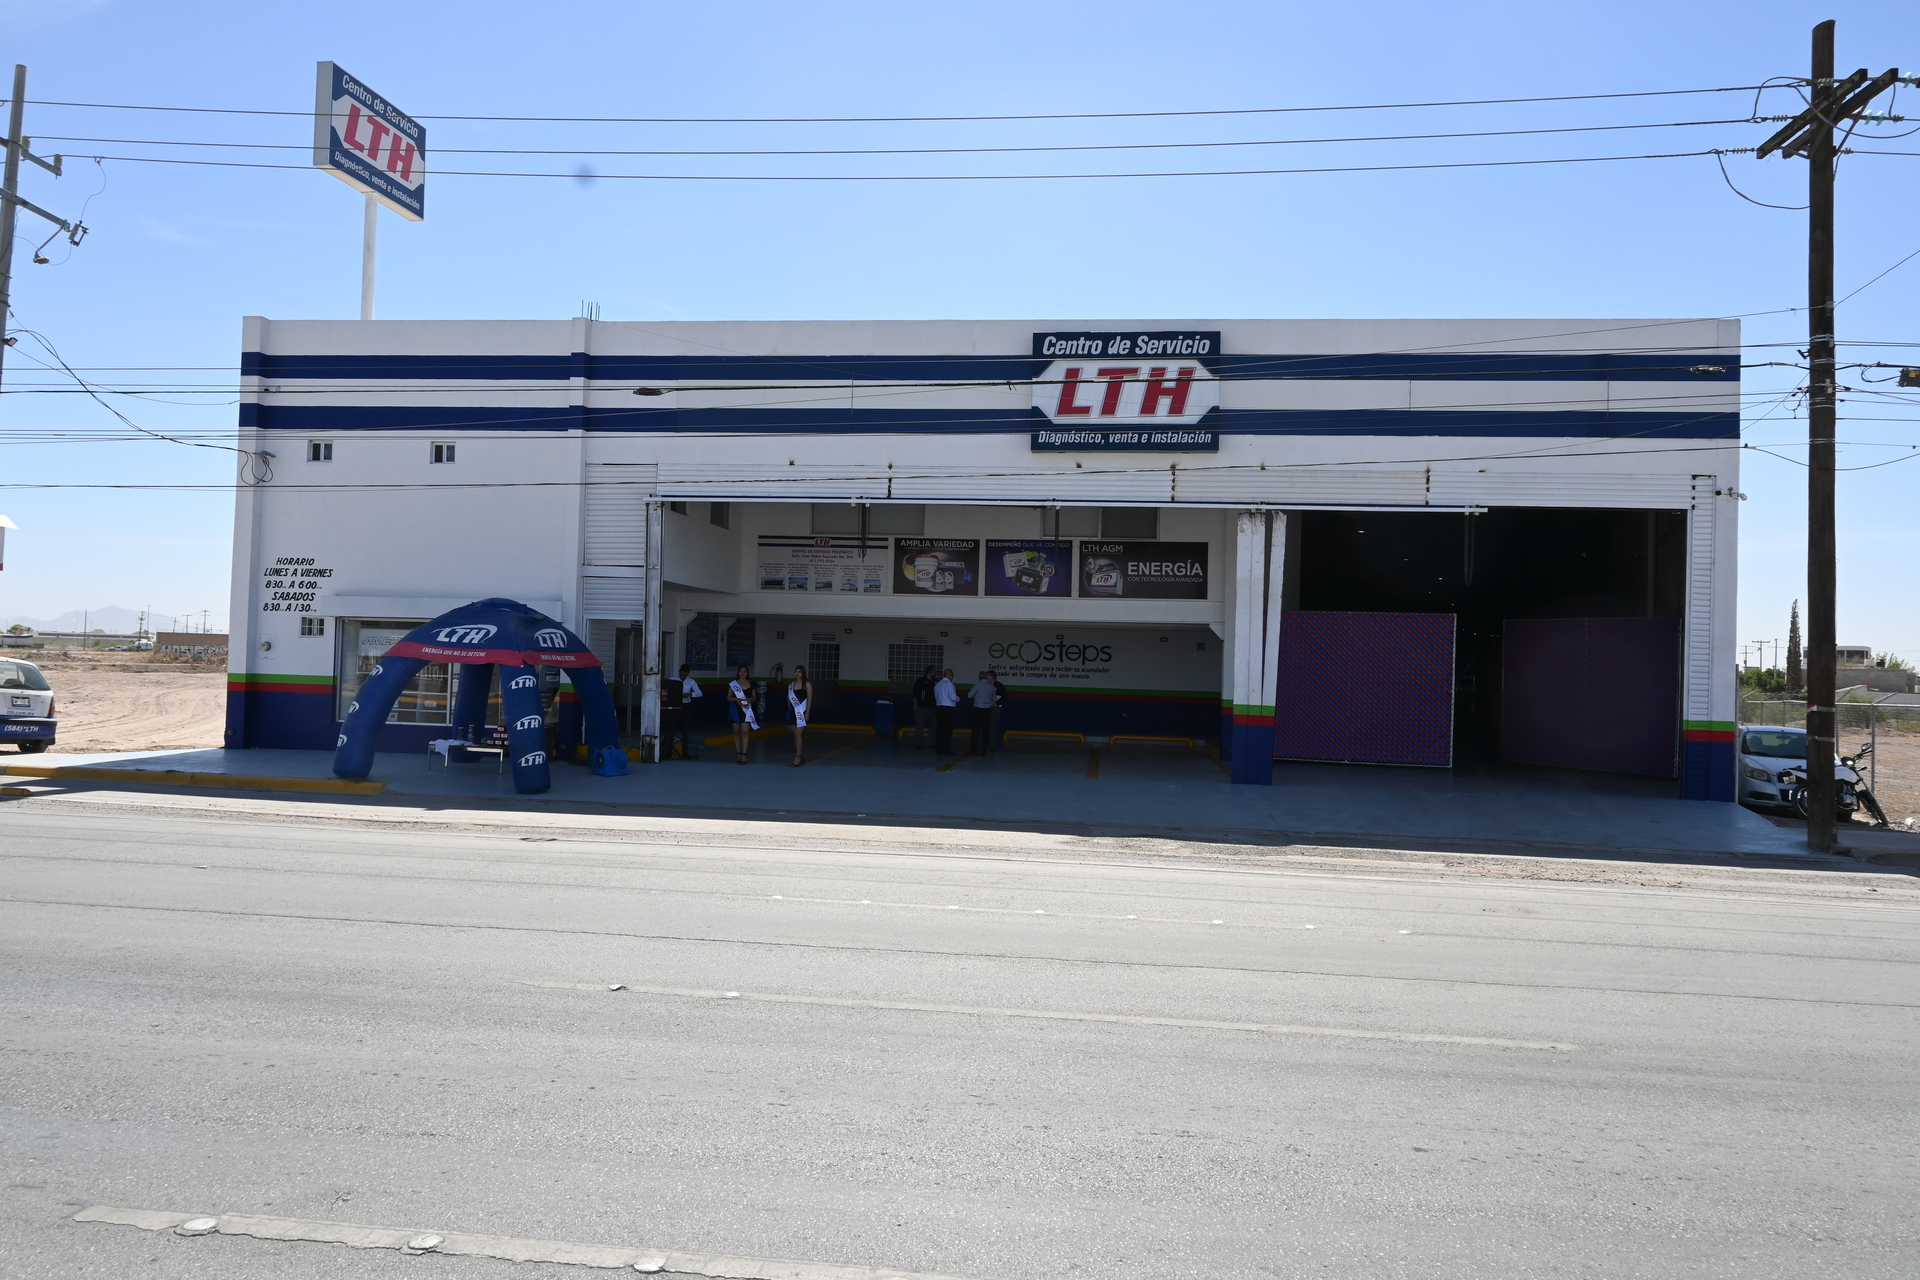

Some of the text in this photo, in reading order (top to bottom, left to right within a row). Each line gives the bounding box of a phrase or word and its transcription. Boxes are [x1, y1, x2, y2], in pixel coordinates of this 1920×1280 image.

[342, 74, 418, 138] Centro de Servicio
[344, 103, 415, 182] LTH
[372, 175, 387, 190] venta
[392, 186, 420, 210] instalación
[1042, 335, 1210, 355] Centro de Servicio
[1054, 367, 1196, 417] LTH
[1038, 430, 1212, 446] Diagnóstico, venta e instalación
[276, 557, 315, 566] HORARIO
[1128, 560, 1203, 576] ENERGÍA
[264, 568, 334, 577] LUNES A VIERNES
[288, 581, 295, 589] A
[271, 591, 316, 601] SABADOS
[285, 603, 292, 611] A
[436, 628, 488, 644] LTH
[536, 633, 565, 648] LTH
[988, 640, 1112, 666] ecosteps
[511, 679, 533, 689] LTH
[516, 719, 538, 730] LTH
[521, 755, 543, 766] LTH
